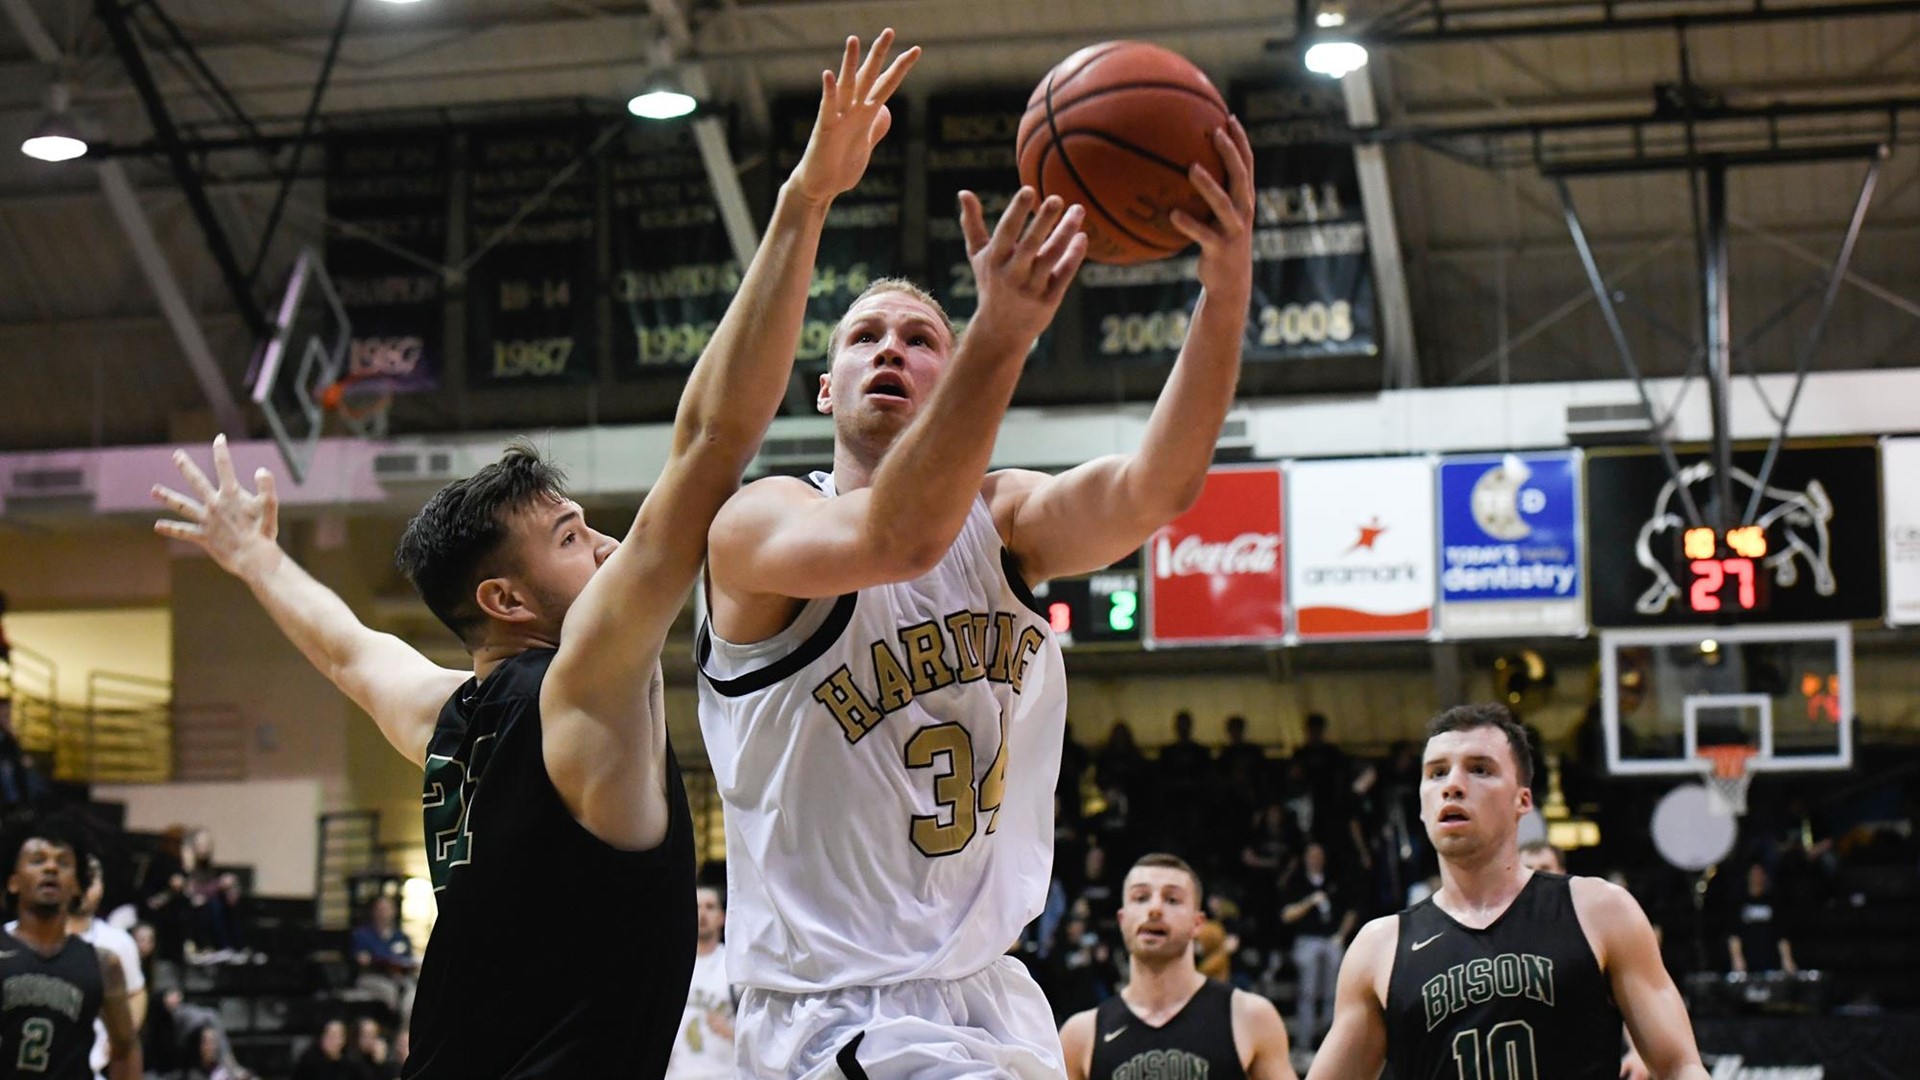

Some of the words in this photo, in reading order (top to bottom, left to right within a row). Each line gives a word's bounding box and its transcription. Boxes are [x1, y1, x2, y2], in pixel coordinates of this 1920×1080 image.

[1259, 300, 1353, 346] 2008
[1304, 562, 1421, 587] aramark
[1443, 562, 1575, 595] dentistry
[1690, 559, 1755, 612] 27
[1110, 590, 1137, 631] 2
[812, 609, 1045, 744] HARDING
[1422, 953, 1555, 1032] BISON
[16, 1017, 54, 1073] 2
[1452, 1019, 1539, 1080] 10
